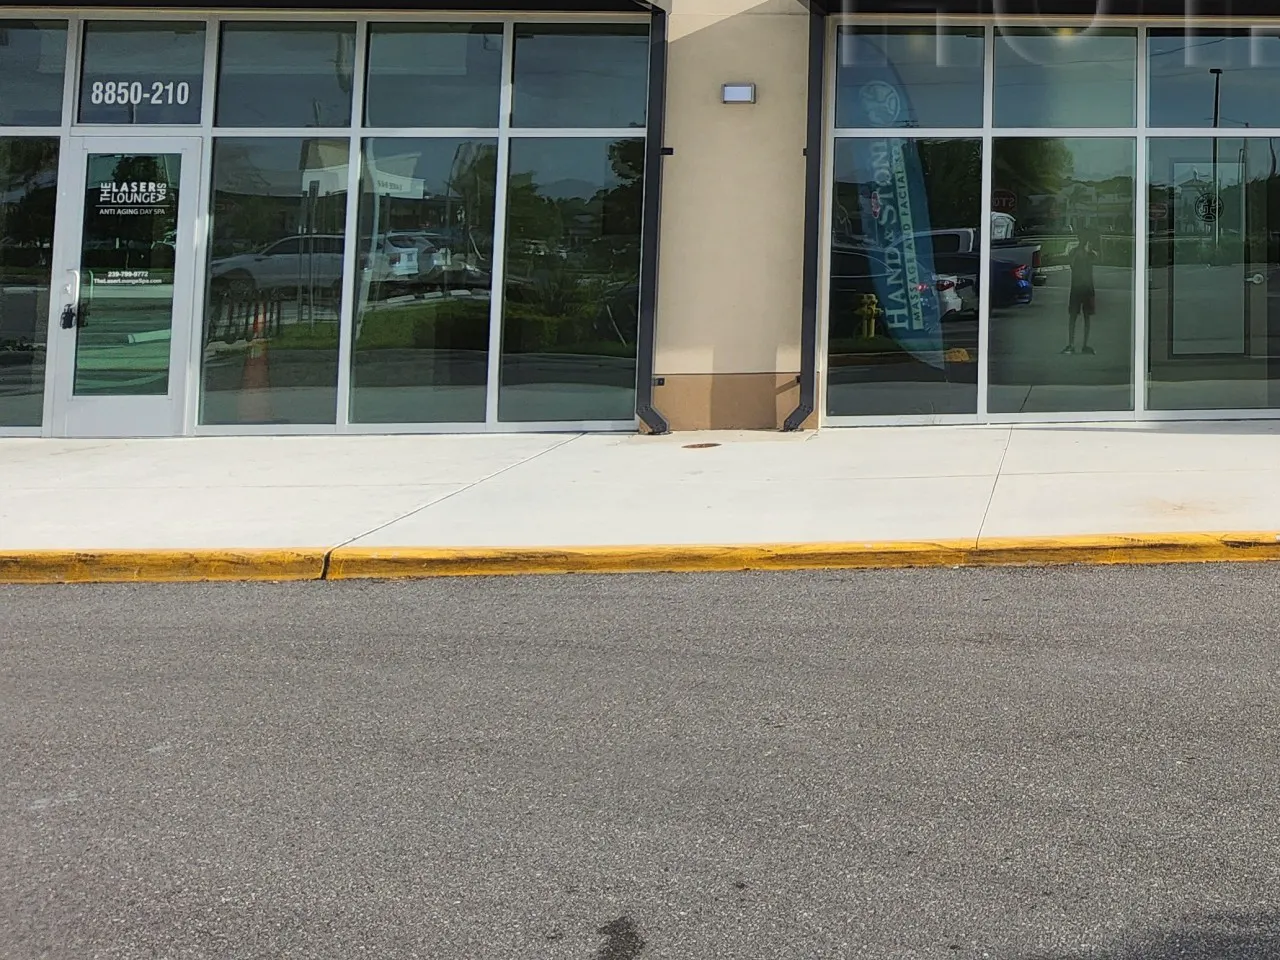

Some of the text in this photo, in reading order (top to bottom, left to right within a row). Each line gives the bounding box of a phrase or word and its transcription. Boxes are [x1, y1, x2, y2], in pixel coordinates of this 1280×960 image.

[91, 81, 189, 105] 8850-210
[100, 182, 111, 202] THE
[111, 192, 156, 203] LOUNGE
[112, 182, 156, 192] LASER
[156, 182, 167, 202] SPA
[898, 170, 908, 216] FACIAL
[884, 246, 909, 330] HAND
[908, 258, 921, 321] MASSAGE
